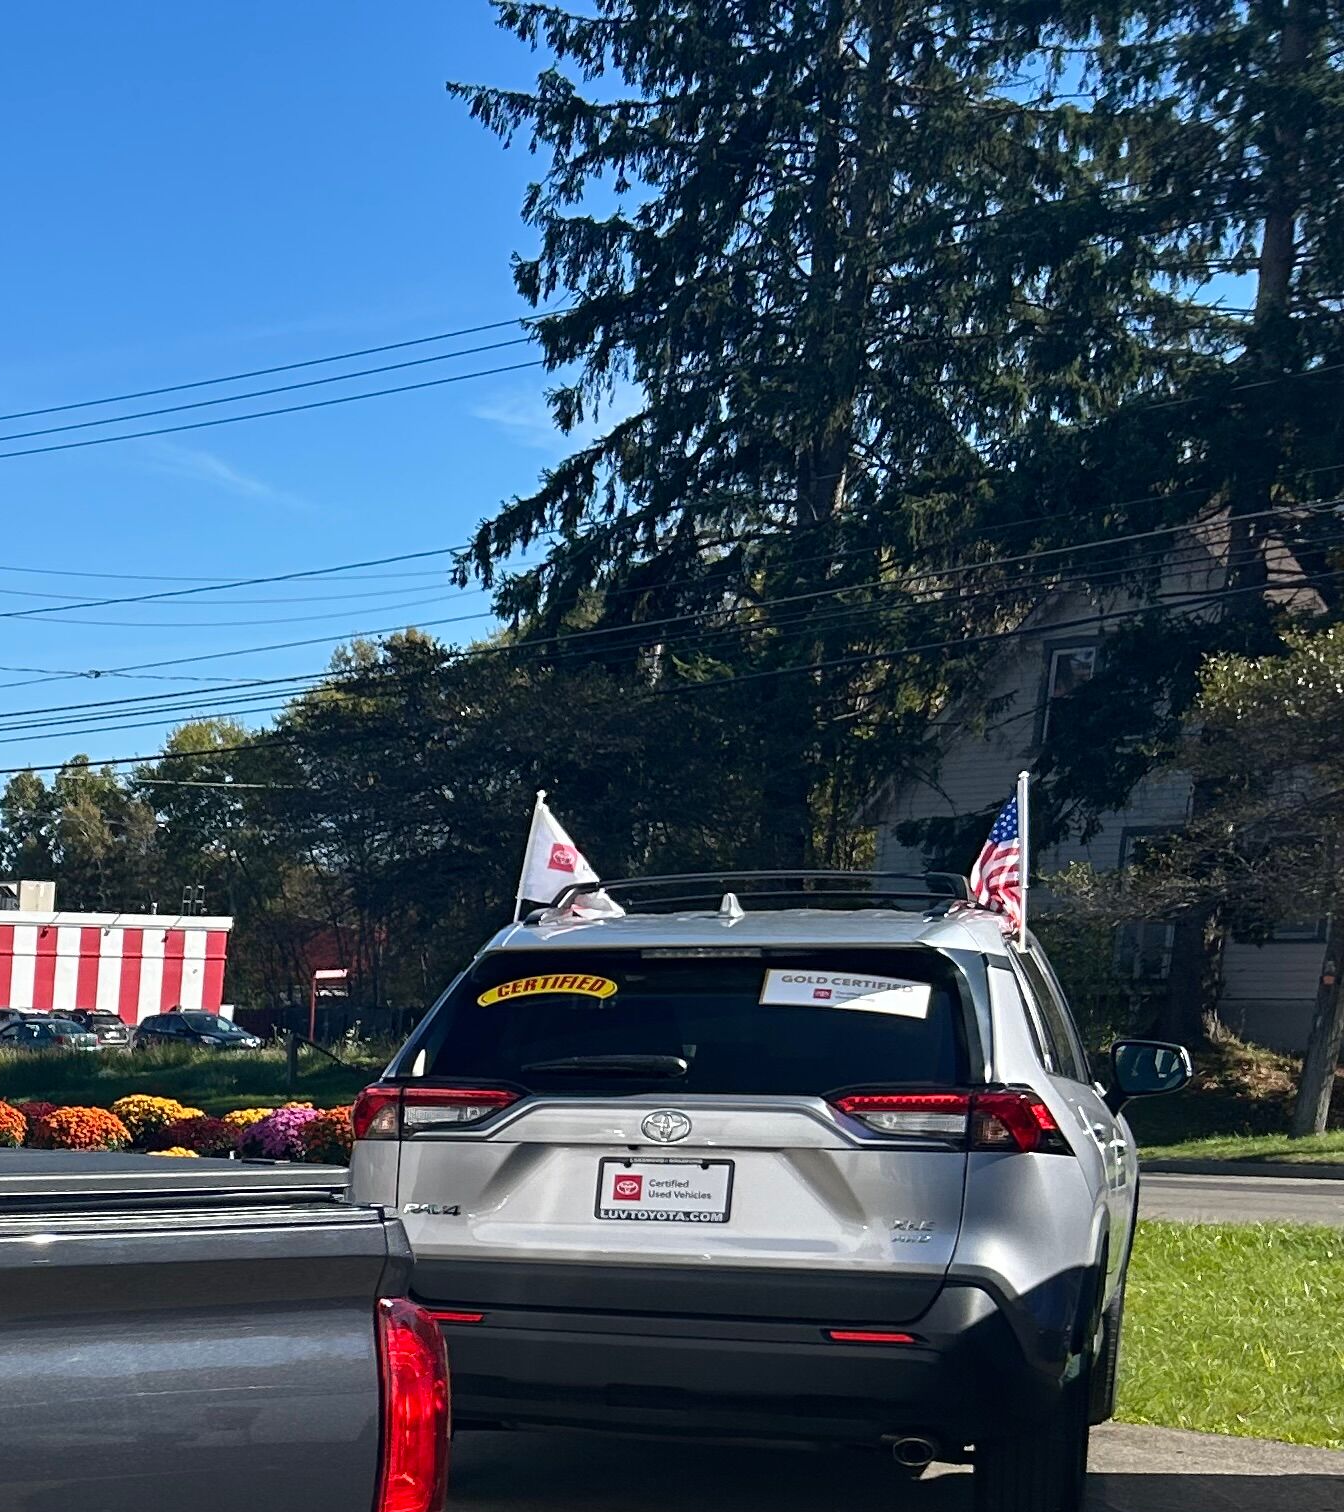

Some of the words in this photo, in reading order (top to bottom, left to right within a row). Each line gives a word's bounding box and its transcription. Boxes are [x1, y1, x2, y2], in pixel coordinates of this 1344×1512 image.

[781, 974, 828, 985] GOLD
[497, 975, 607, 998] CERTIFIED
[648, 1179, 690, 1189] Certified
[648, 1190, 672, 1200] Used
[673, 1191, 712, 1200] Vehicles
[600, 1209, 724, 1222] LUVTOYOTA.COM
